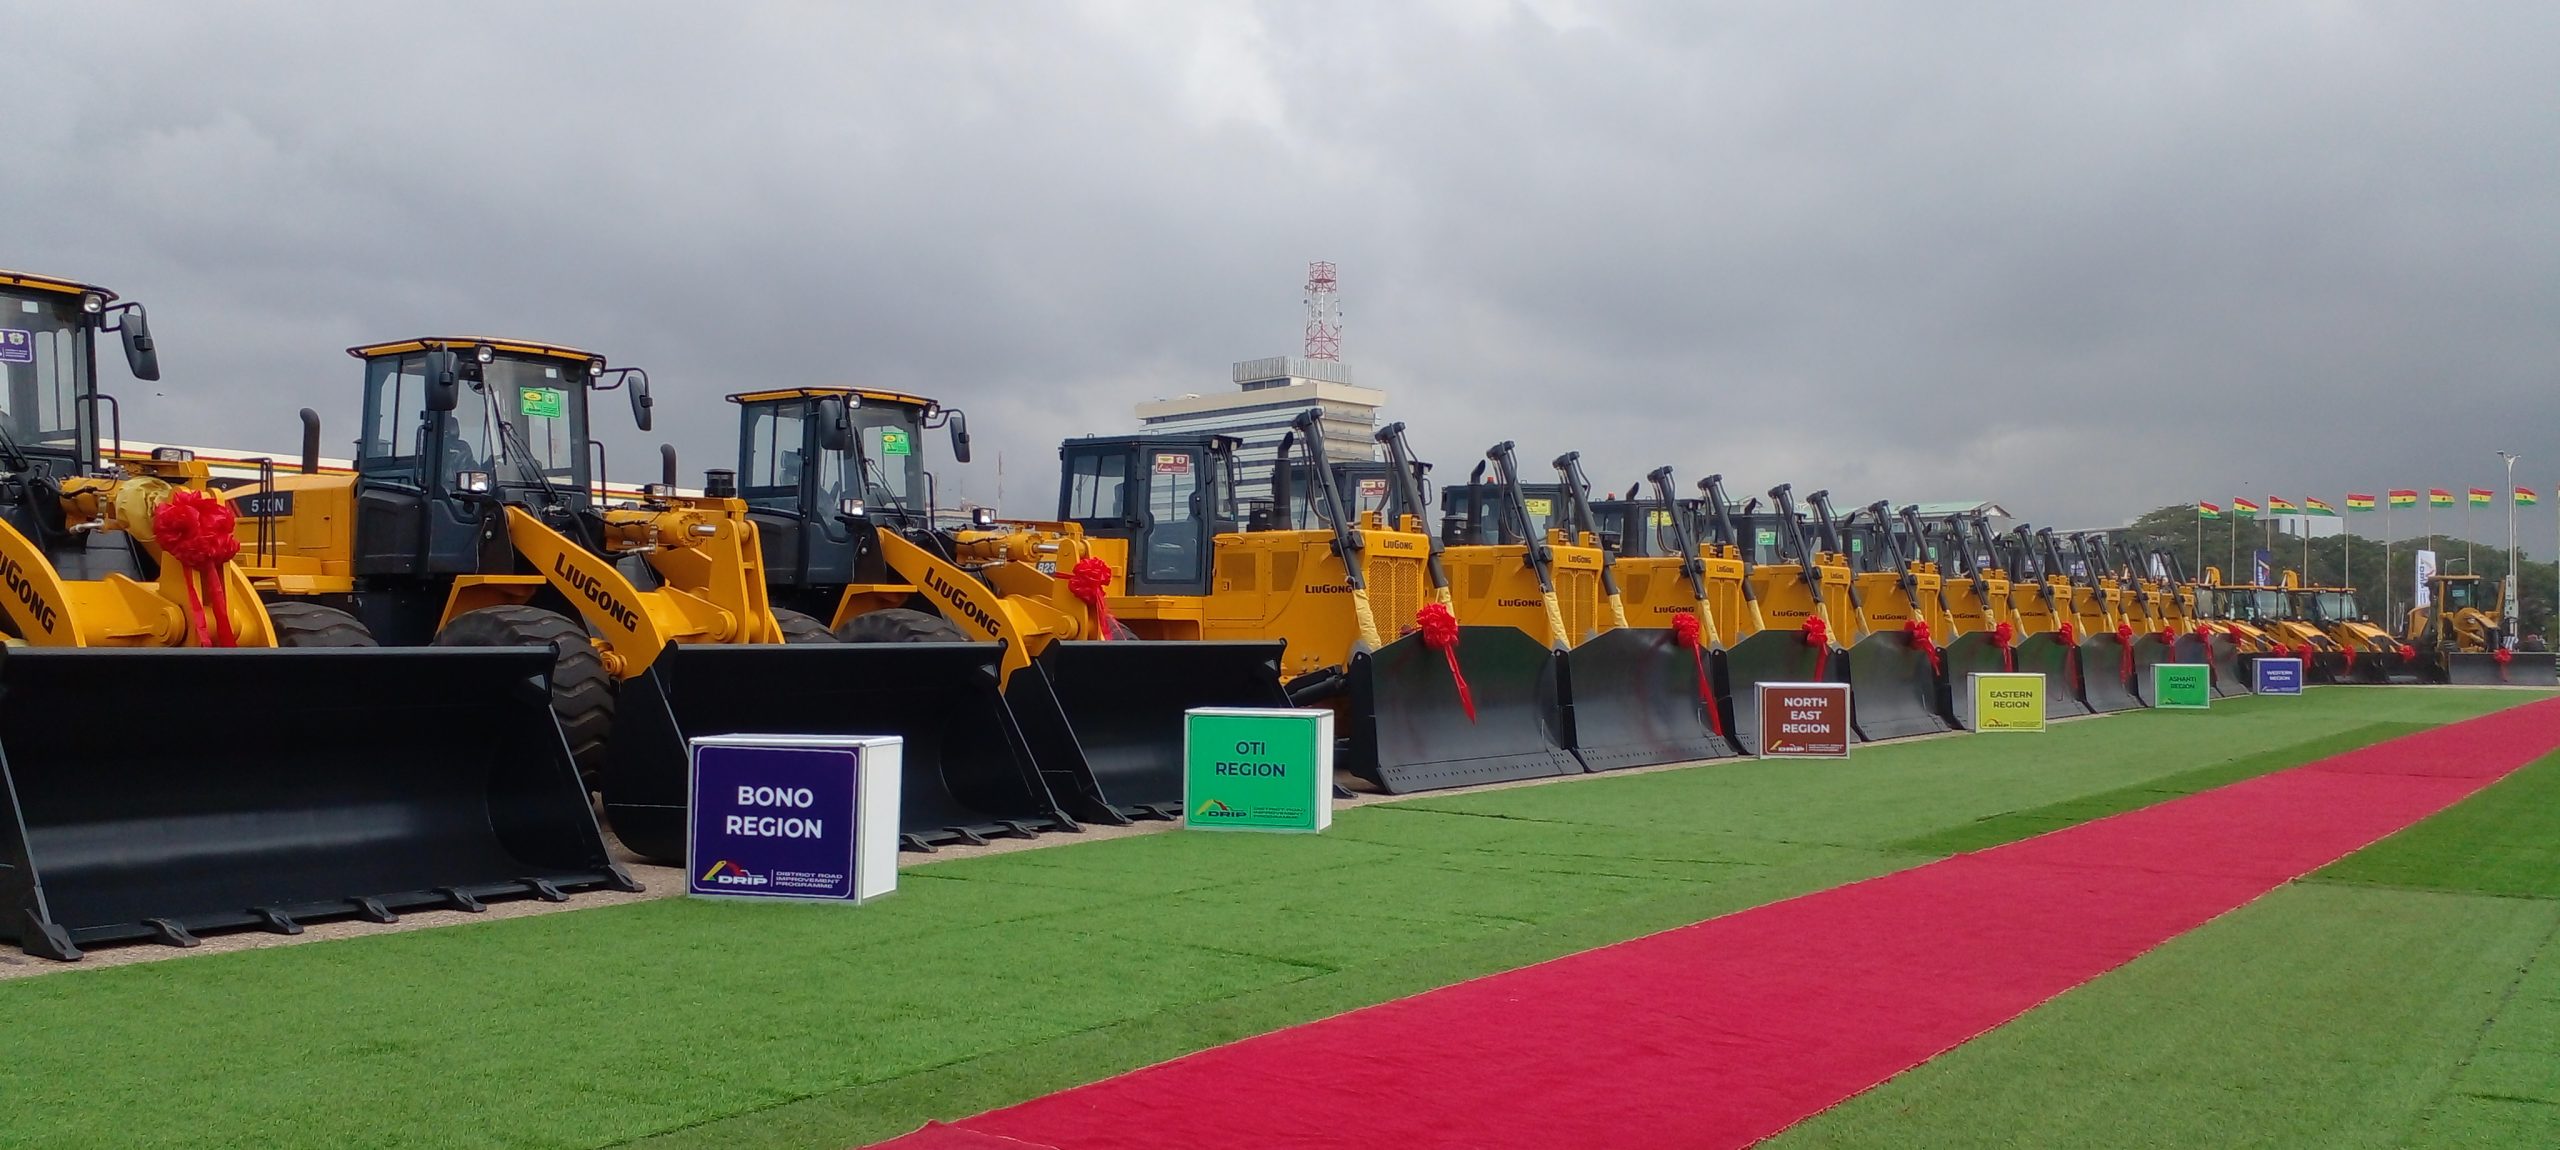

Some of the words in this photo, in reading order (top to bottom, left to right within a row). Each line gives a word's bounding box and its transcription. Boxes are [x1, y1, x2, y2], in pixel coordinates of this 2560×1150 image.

[1784, 697, 1828, 707] NORTH
[1790, 710, 1822, 720] EAST
[1782, 723, 1830, 733] REGION
[1236, 741, 1265, 755] OTI
[1216, 762, 1285, 777] REGION
[738, 785, 814, 808] BONO
[726, 815, 823, 839] REGION
[718, 875, 768, 885] DRIP
[775, 881, 833, 889] PROGRAMME
[776, 876, 840, 884] IMPROVEMENT
